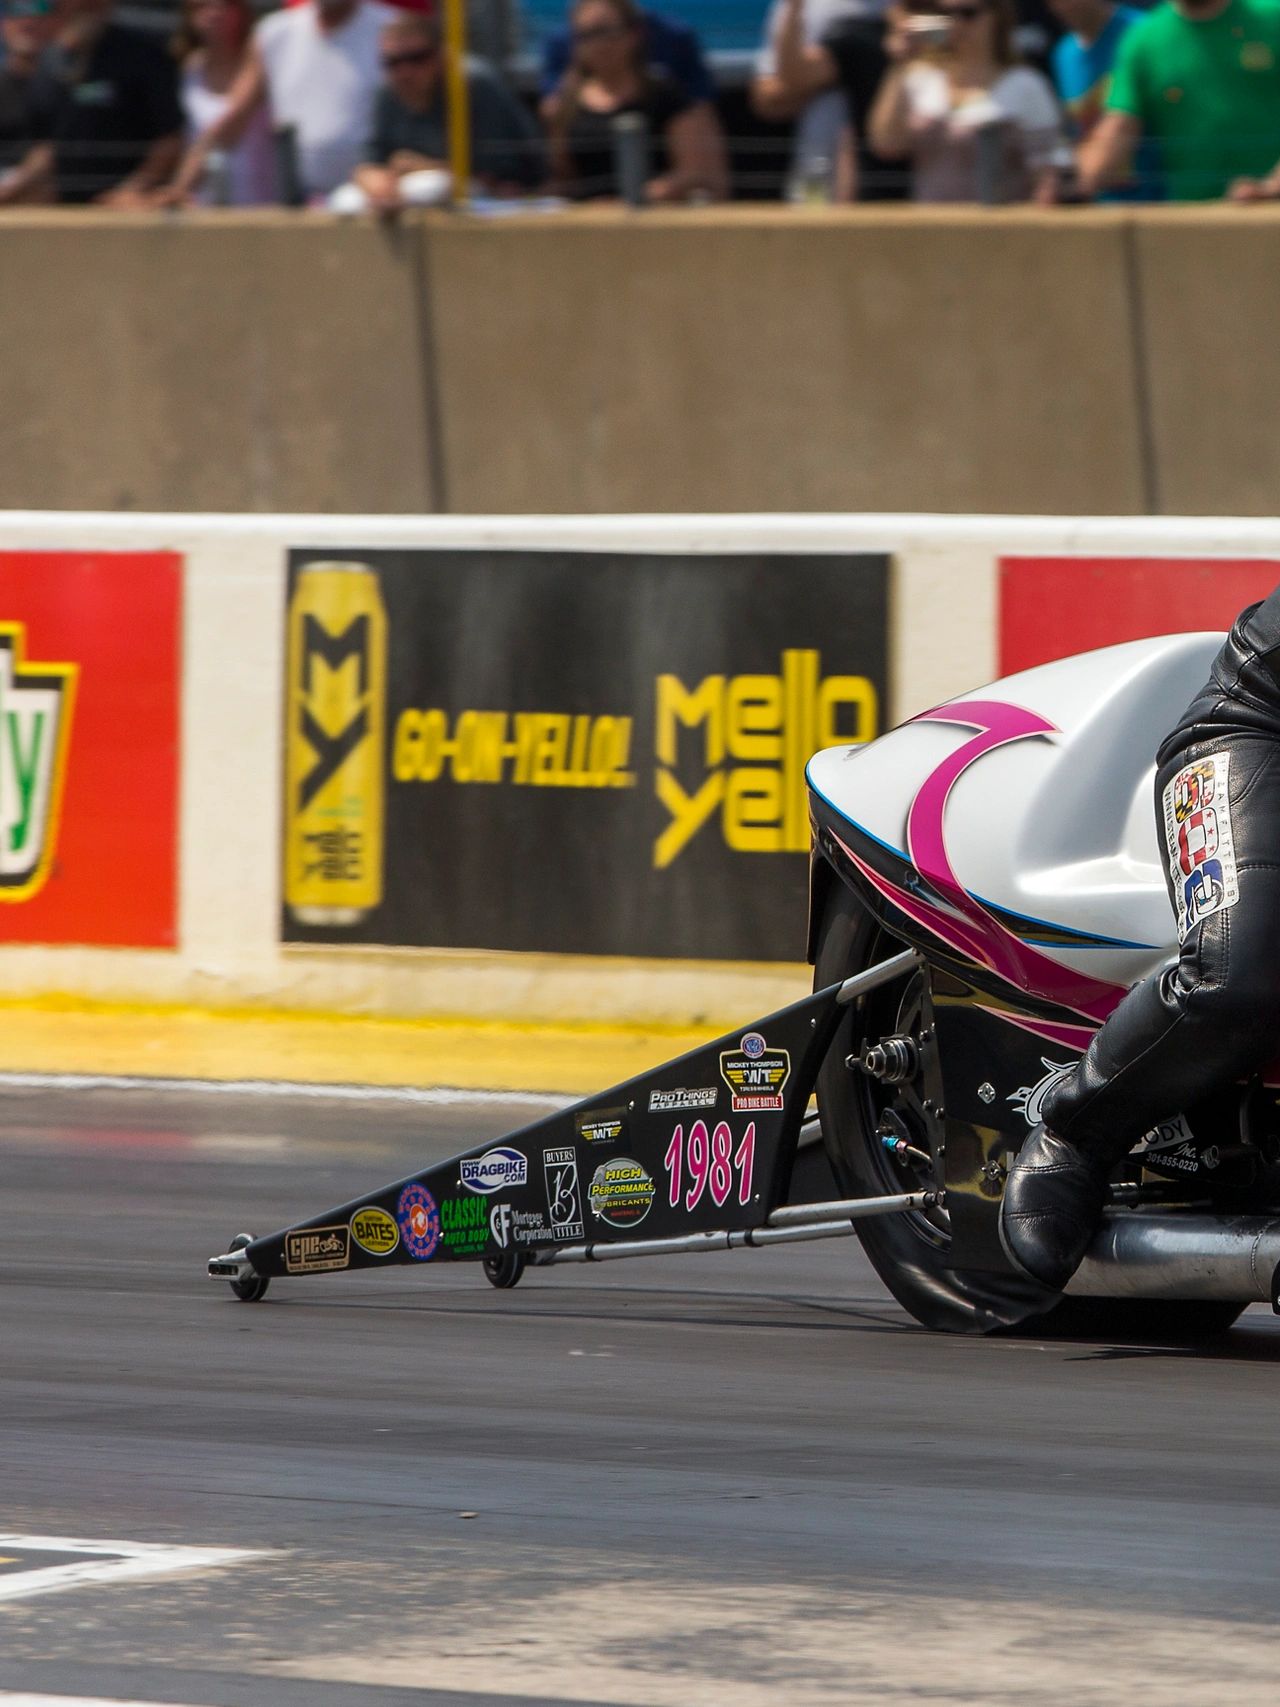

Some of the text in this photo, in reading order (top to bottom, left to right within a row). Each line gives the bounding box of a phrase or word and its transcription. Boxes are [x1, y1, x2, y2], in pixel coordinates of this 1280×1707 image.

[736, 1096, 779, 1108] PRO BIKE BATTLE
[1144, 1120, 1184, 1144] ODY
[546, 1150, 574, 1163] BUYERS
[664, 1120, 756, 1212] 1981
[462, 1161, 526, 1179] DRAGBIKE
[605, 1168, 641, 1180] HIGH
[441, 1196, 489, 1230] CLASSIC
[511, 1209, 544, 1228] Mortgage
[355, 1221, 395, 1241] BATES
[513, 1224, 552, 1245] Corporation
[555, 1225, 582, 1238] TITLE
